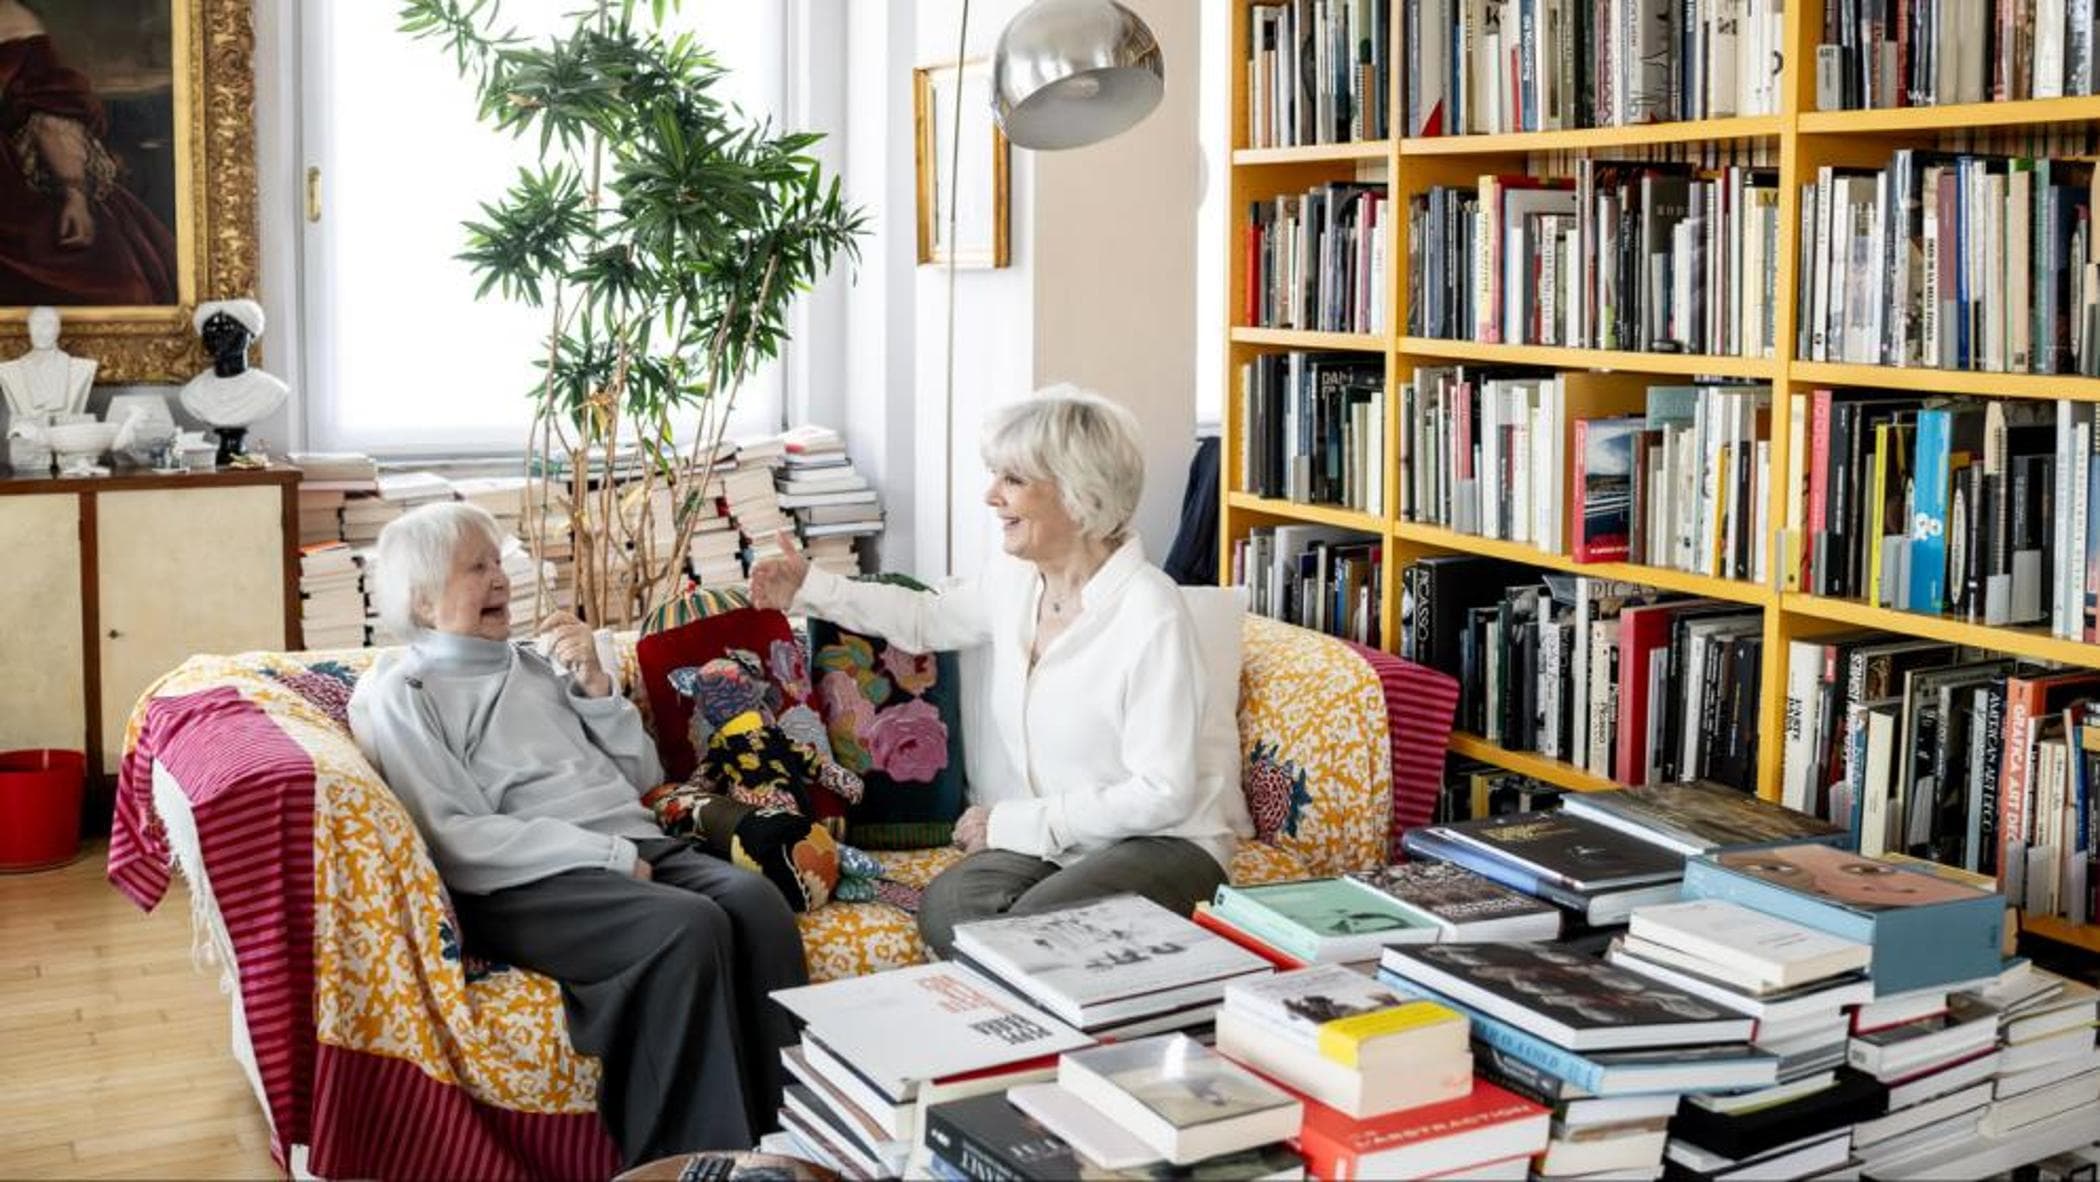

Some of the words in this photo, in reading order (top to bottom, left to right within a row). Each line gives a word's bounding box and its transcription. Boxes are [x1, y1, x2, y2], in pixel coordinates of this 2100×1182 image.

[1417, 569, 1431, 641] PICASSO
[2010, 704, 2026, 772] GRAFICA
[2007, 775, 2021, 811] ART
